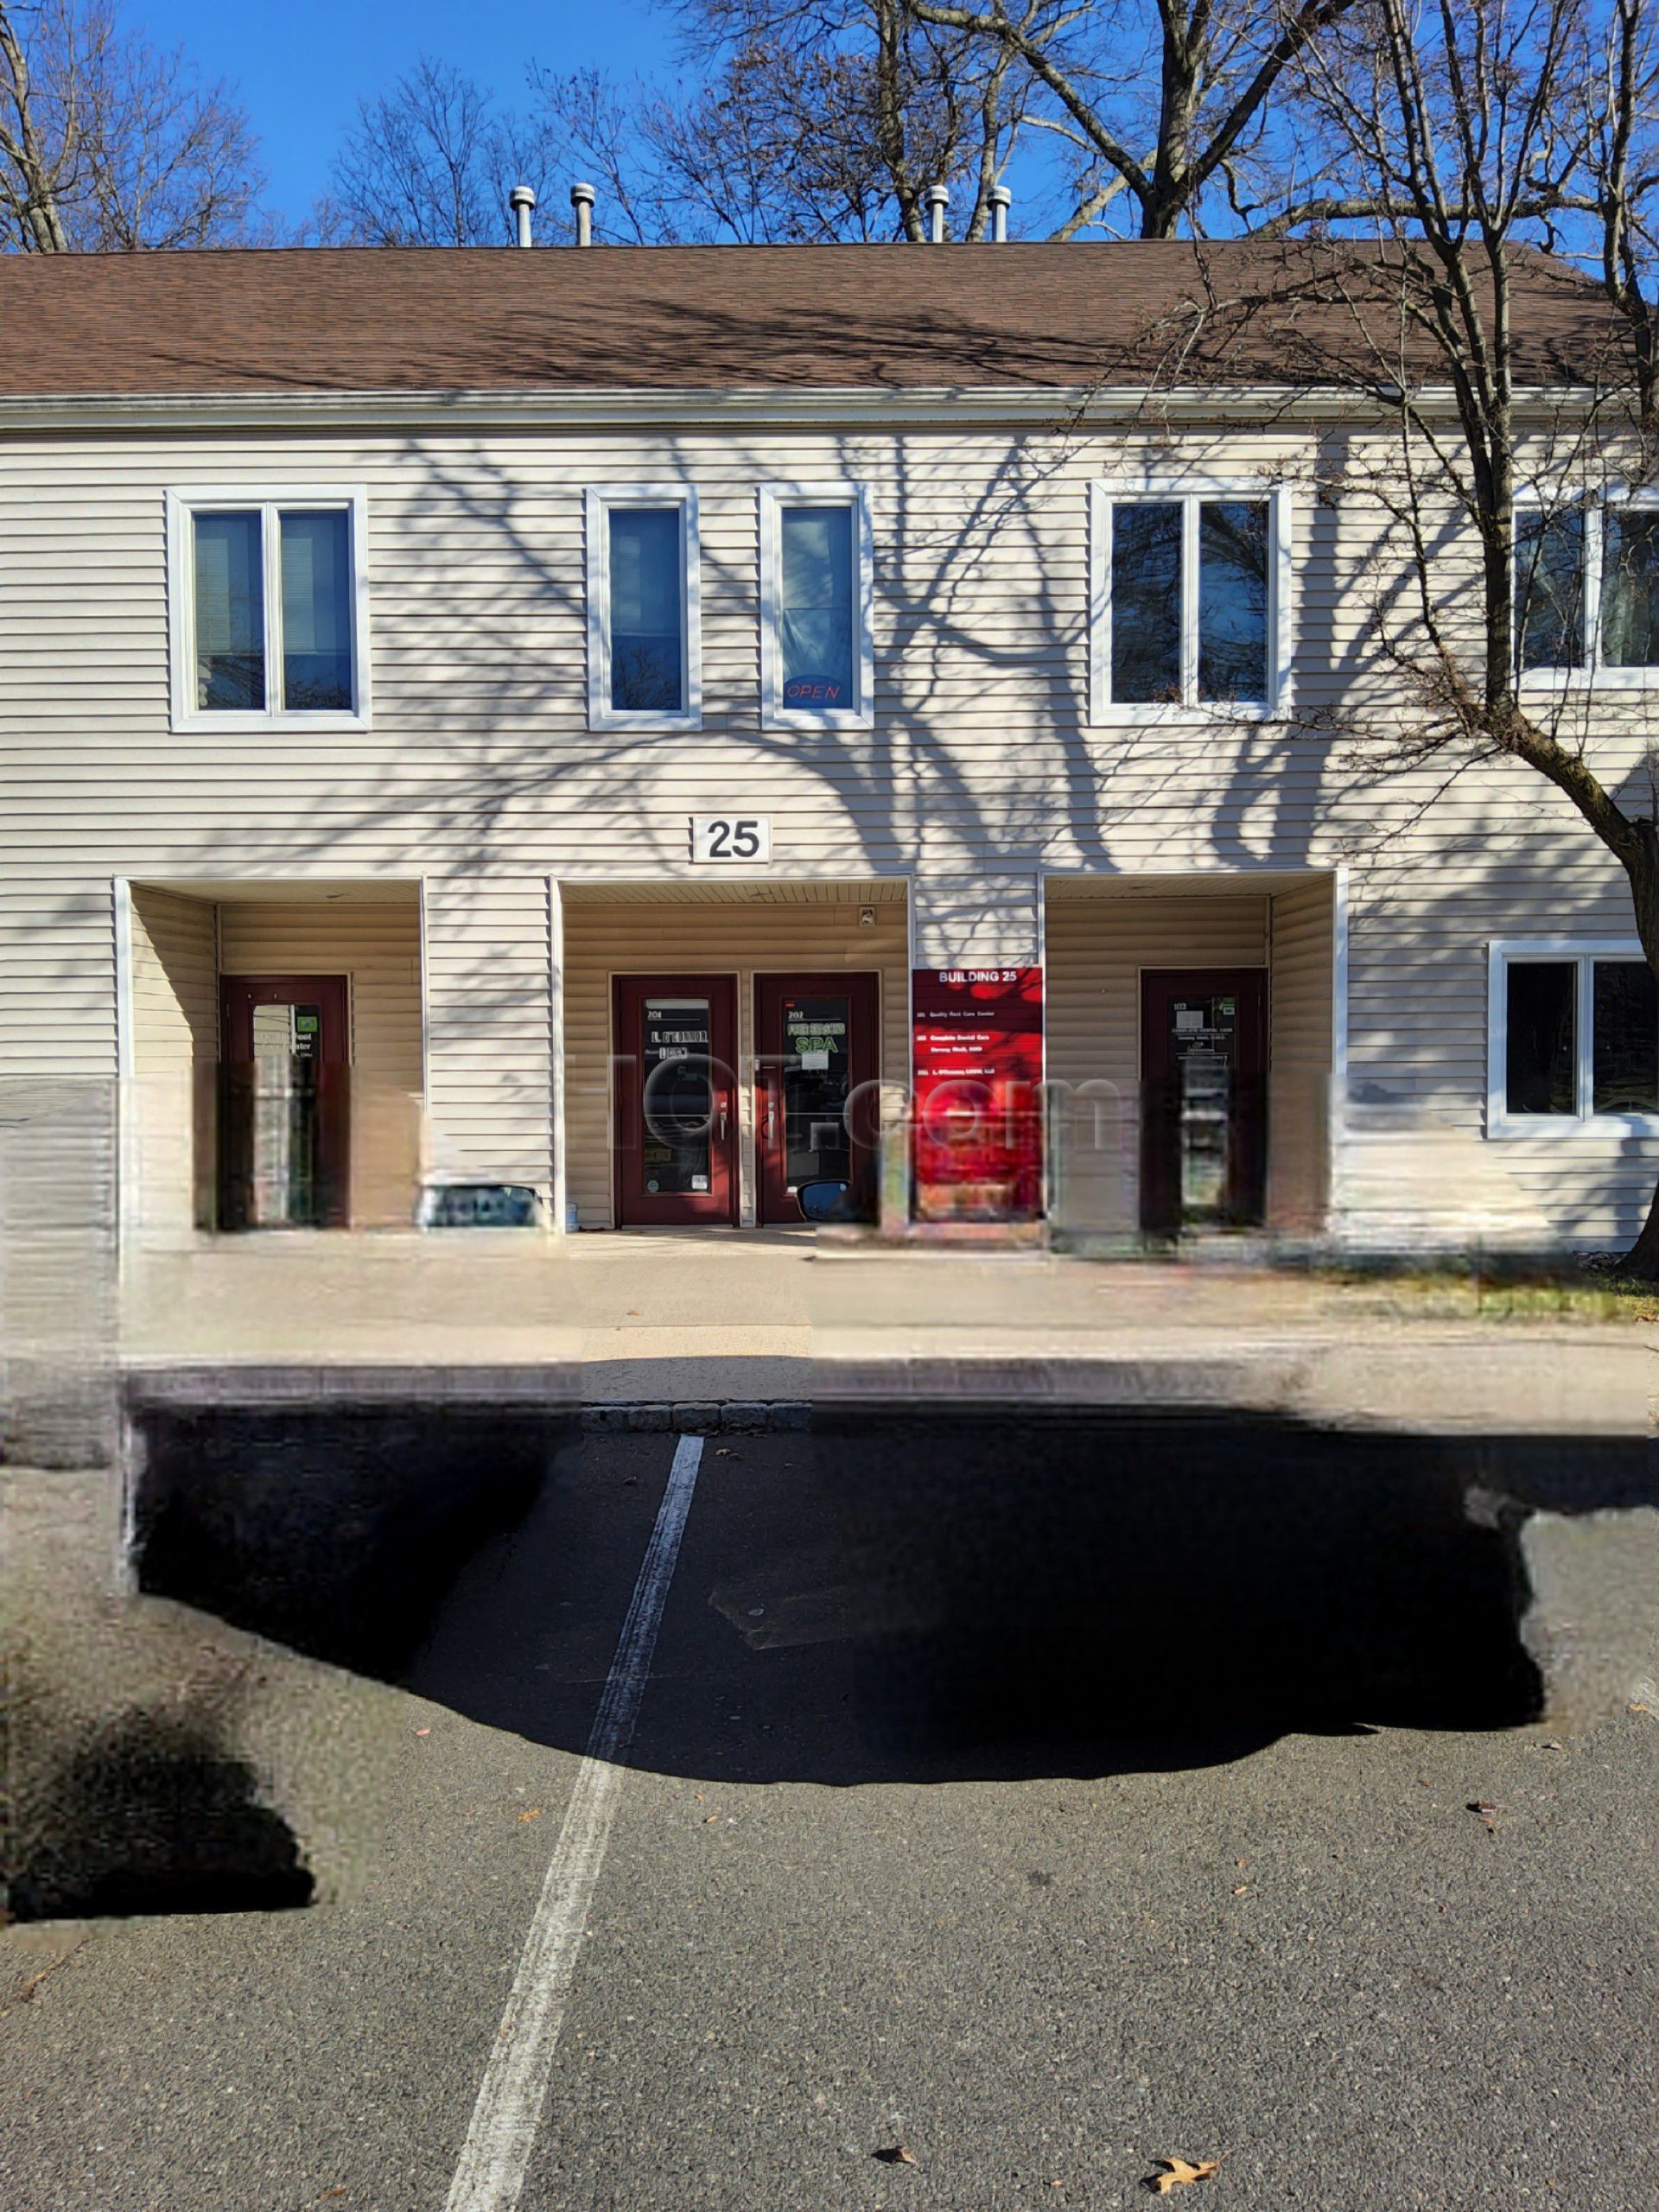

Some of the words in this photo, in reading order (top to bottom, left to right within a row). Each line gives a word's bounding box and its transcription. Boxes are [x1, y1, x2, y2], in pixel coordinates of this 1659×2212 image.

[787, 684, 841, 699] OPEN
[708, 820, 760, 858] 25
[939, 971, 999, 982] BUILDING
[1002, 971, 1017, 982] 25
[796, 1036, 838, 1053] SPA
